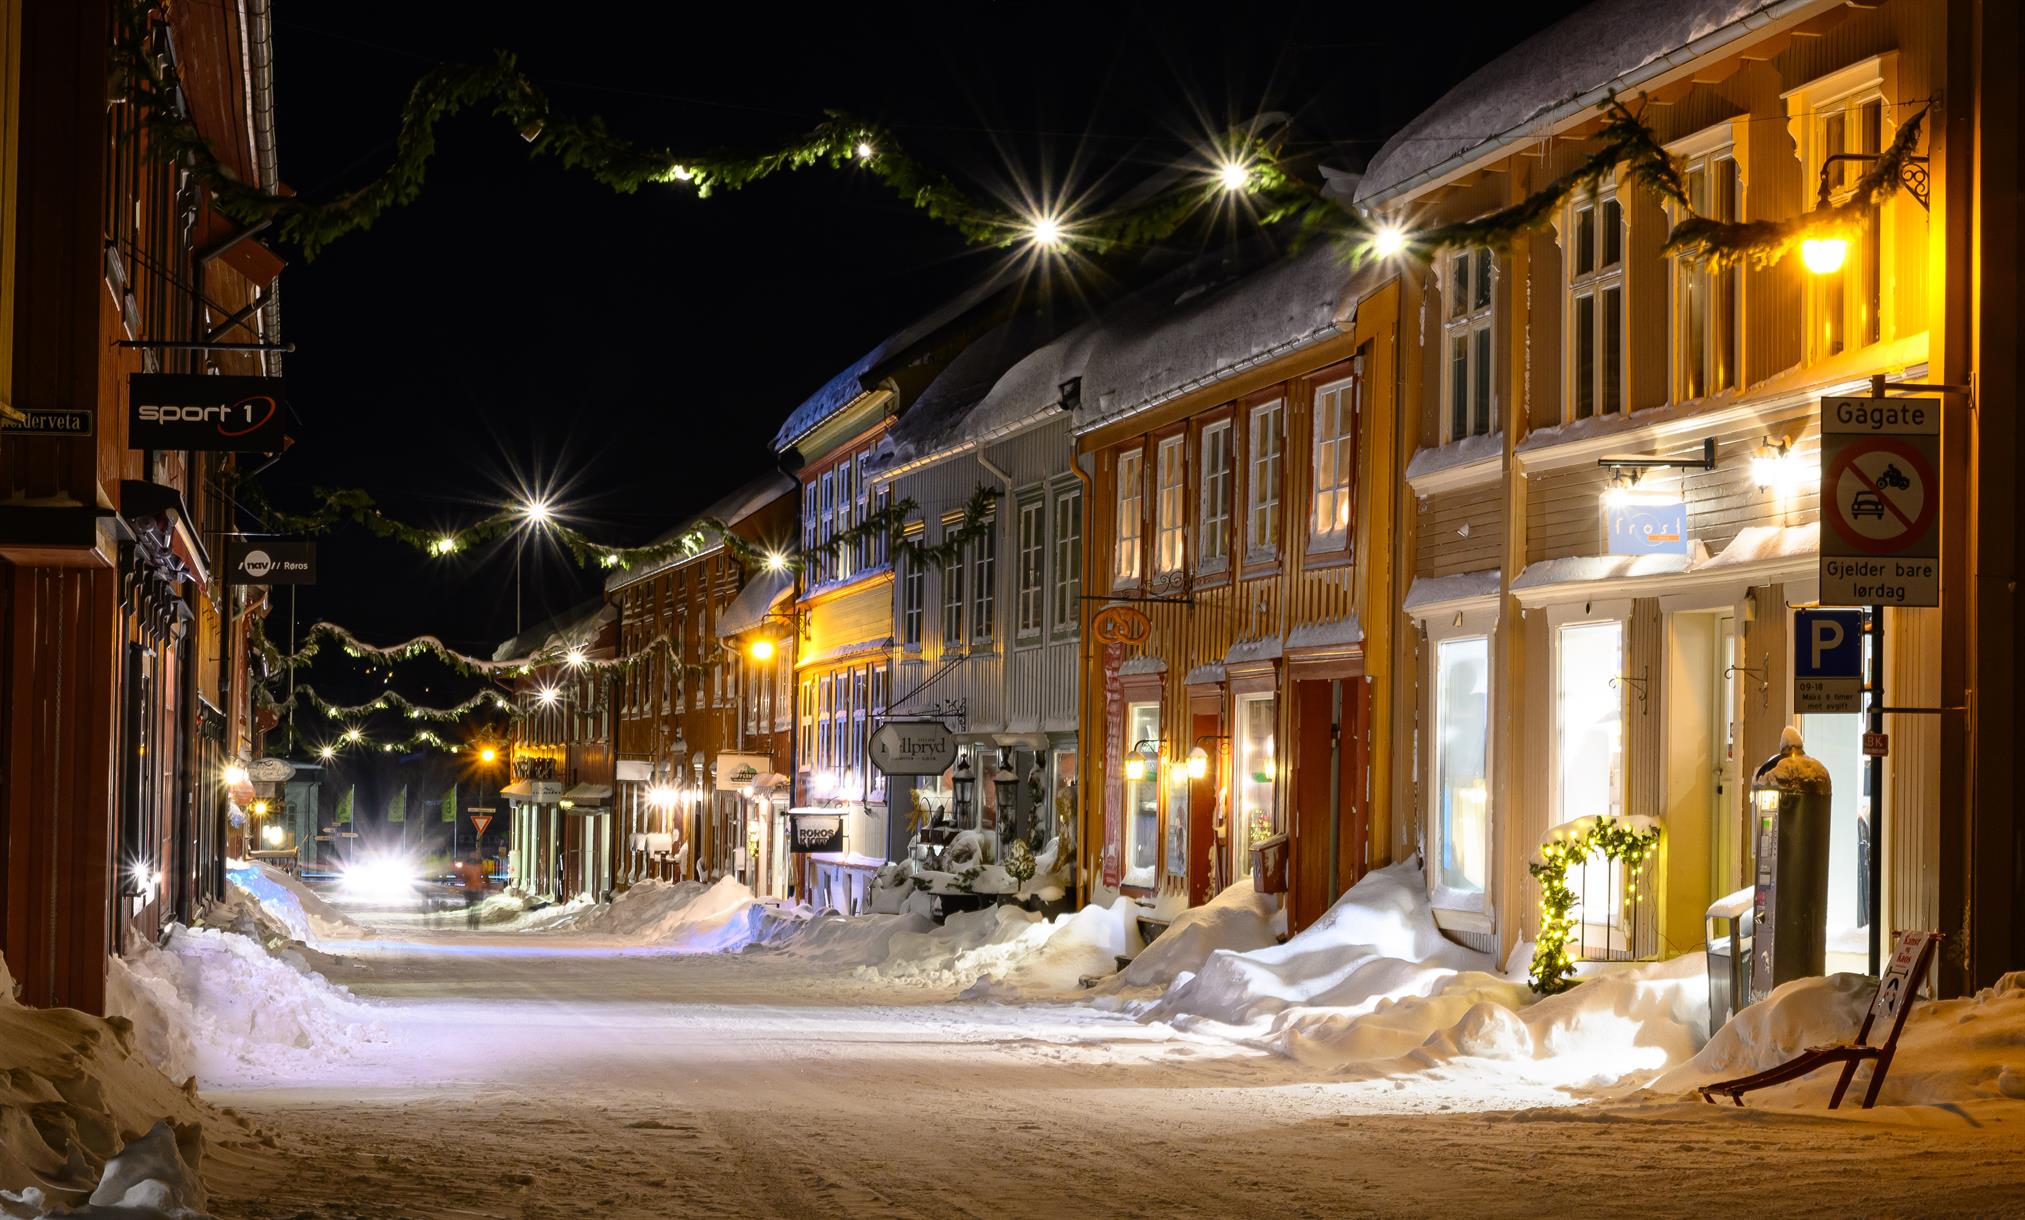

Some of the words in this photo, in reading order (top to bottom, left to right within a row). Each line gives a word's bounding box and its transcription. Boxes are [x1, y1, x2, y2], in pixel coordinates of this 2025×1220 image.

[138, 403, 231, 425] sport
[243, 404, 252, 423] 1
[1836, 402, 1925, 429] Gågate
[284, 561, 308, 571] Røros
[1827, 561, 1886, 580] Gjelder
[1896, 562, 1932, 577] bare
[1854, 583, 1905, 601] lørdag
[1811, 620, 1844, 669] P
[1800, 683, 1823, 691] 09-18
